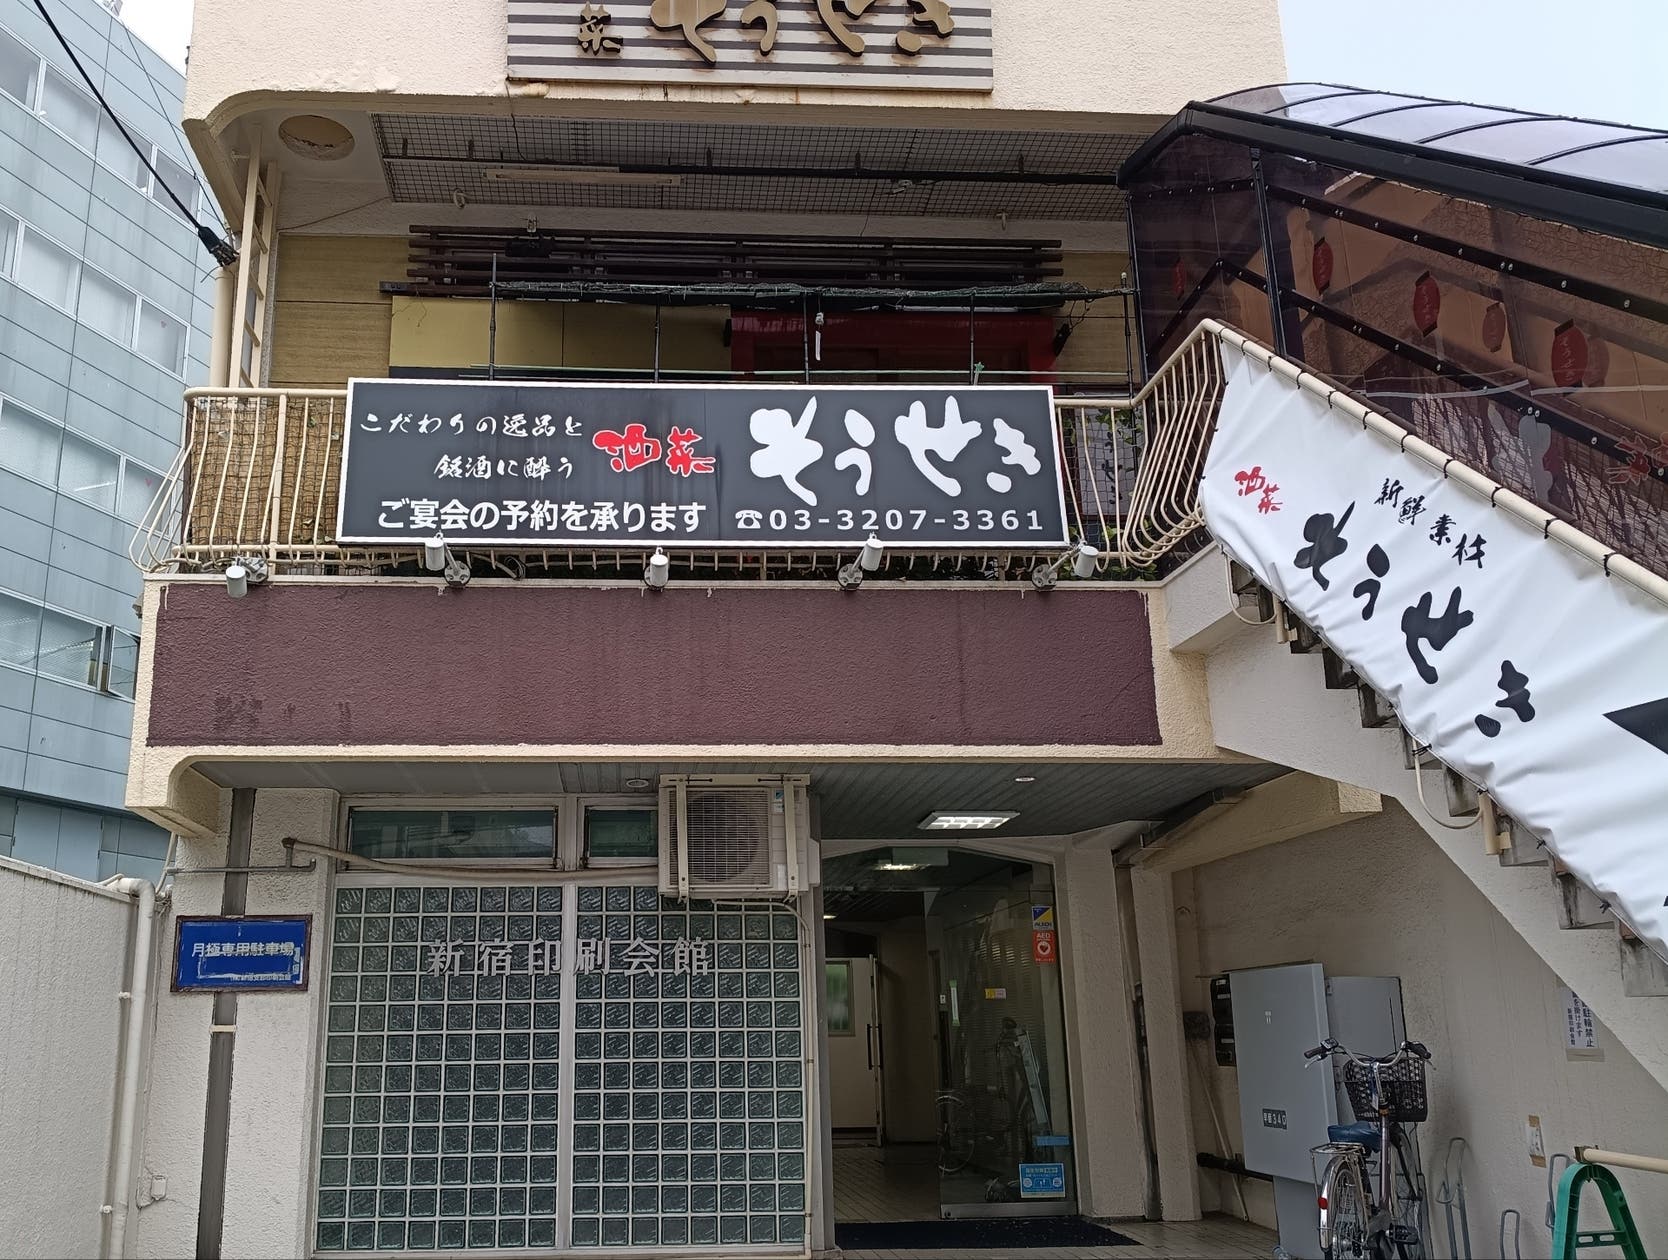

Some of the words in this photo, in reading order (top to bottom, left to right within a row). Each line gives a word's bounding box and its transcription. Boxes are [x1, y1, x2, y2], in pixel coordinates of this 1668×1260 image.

[360, 412, 583, 438] こだわりの逸品と
[433, 454, 575, 481] 銘酒に酔う
[592, 423, 717, 477] 酒菜
[750, 395, 1042, 507] そうせき
[1234, 466, 1284, 515] 酒菜
[378, 497, 707, 533] ご宴会の予約を承ります
[769, 509, 1043, 531] 03-3207-3361
[1374, 477, 1487, 569] 新鮮素材
[1293, 500, 1536, 738] そうせき
[191, 941, 295, 957] 月極専用駐車場
[426, 936, 710, 978] 新宿印刷会館
